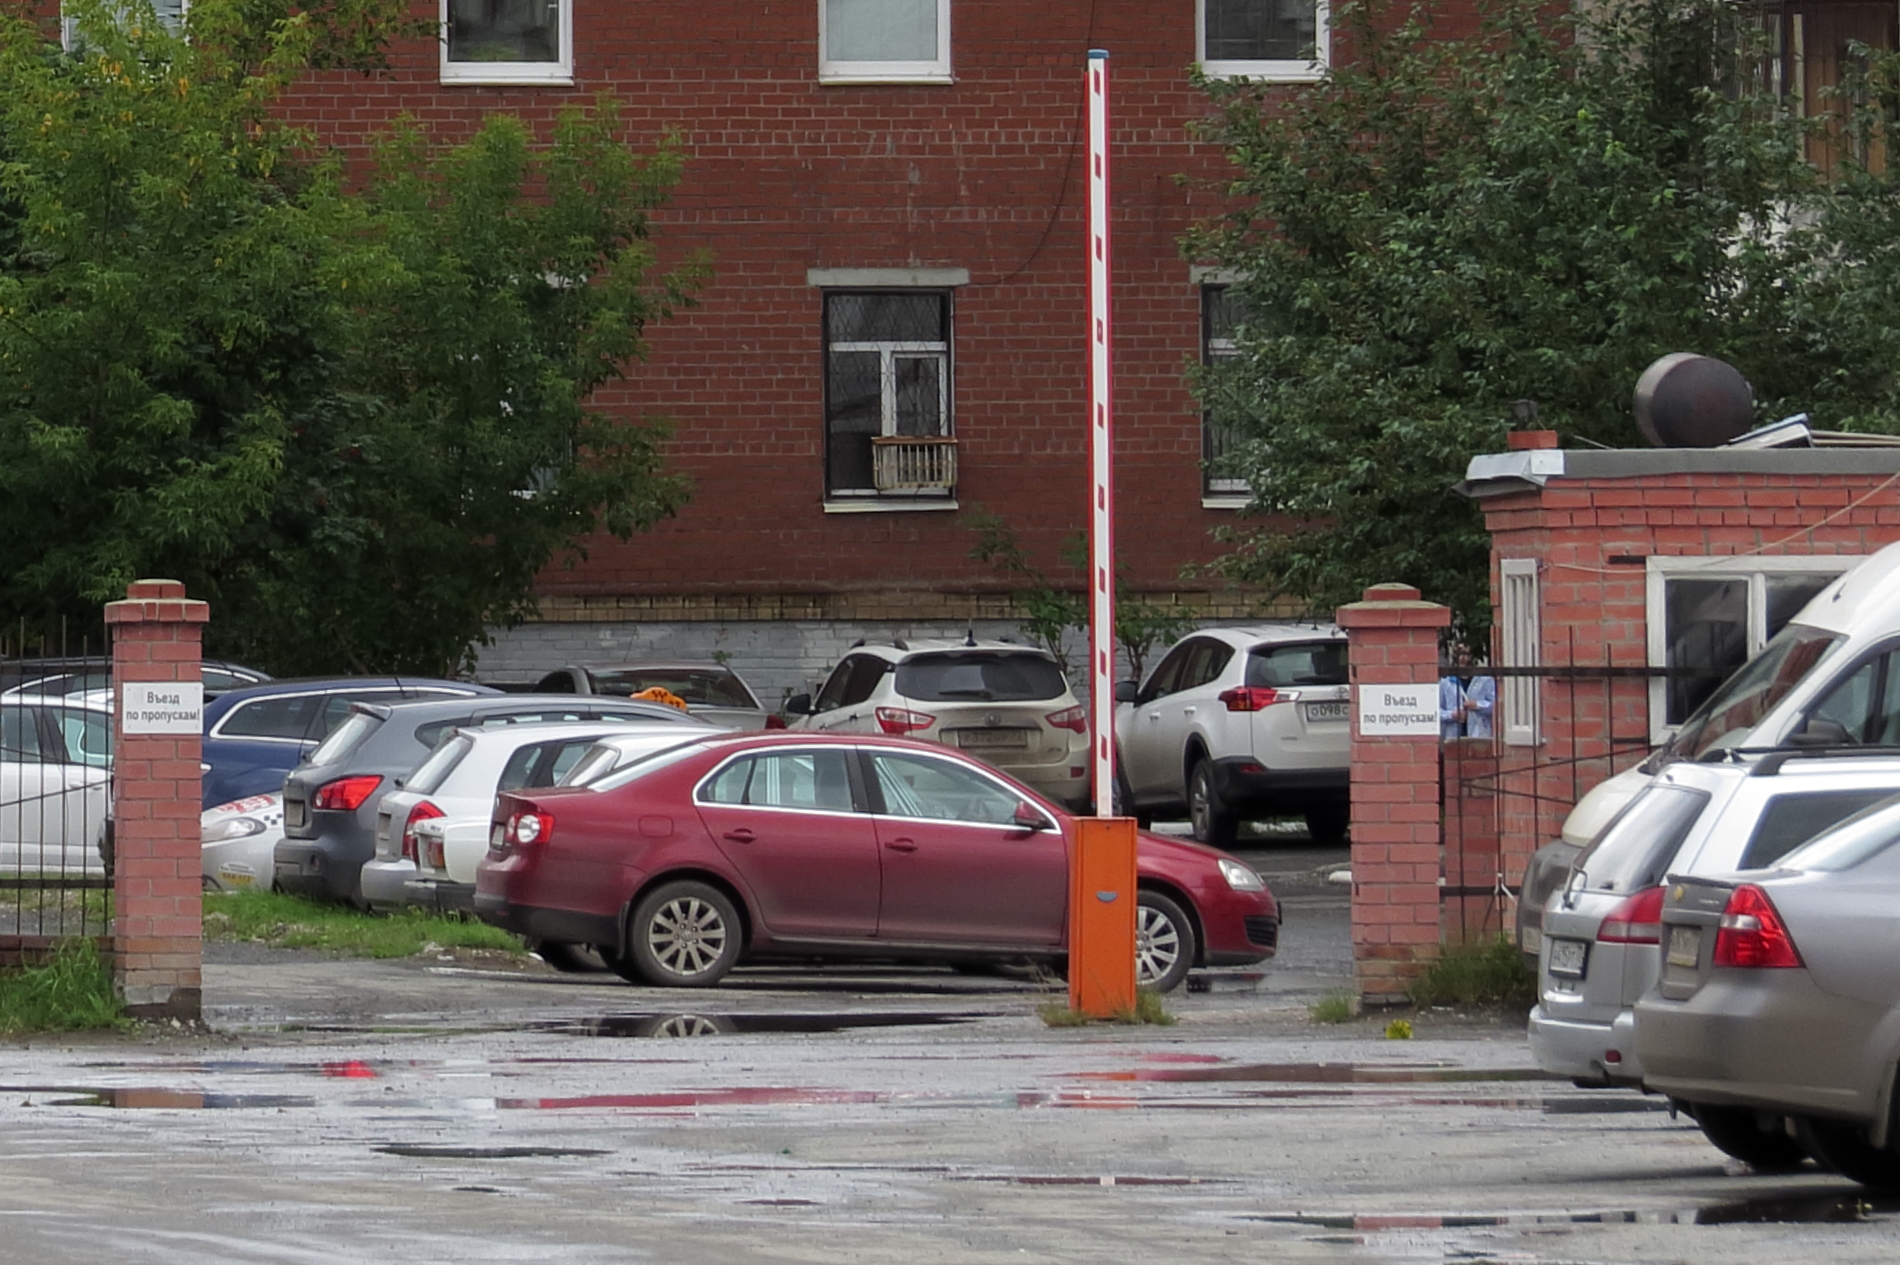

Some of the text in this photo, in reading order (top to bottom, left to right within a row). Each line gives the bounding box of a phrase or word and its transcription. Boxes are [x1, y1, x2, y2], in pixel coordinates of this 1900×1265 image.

[147, 691, 179, 704] Въезд
[1384, 694, 1417, 706] Въезд
[126, 708, 200, 723] по пропускам!
[1363, 711, 1437, 725] по пропускам!
